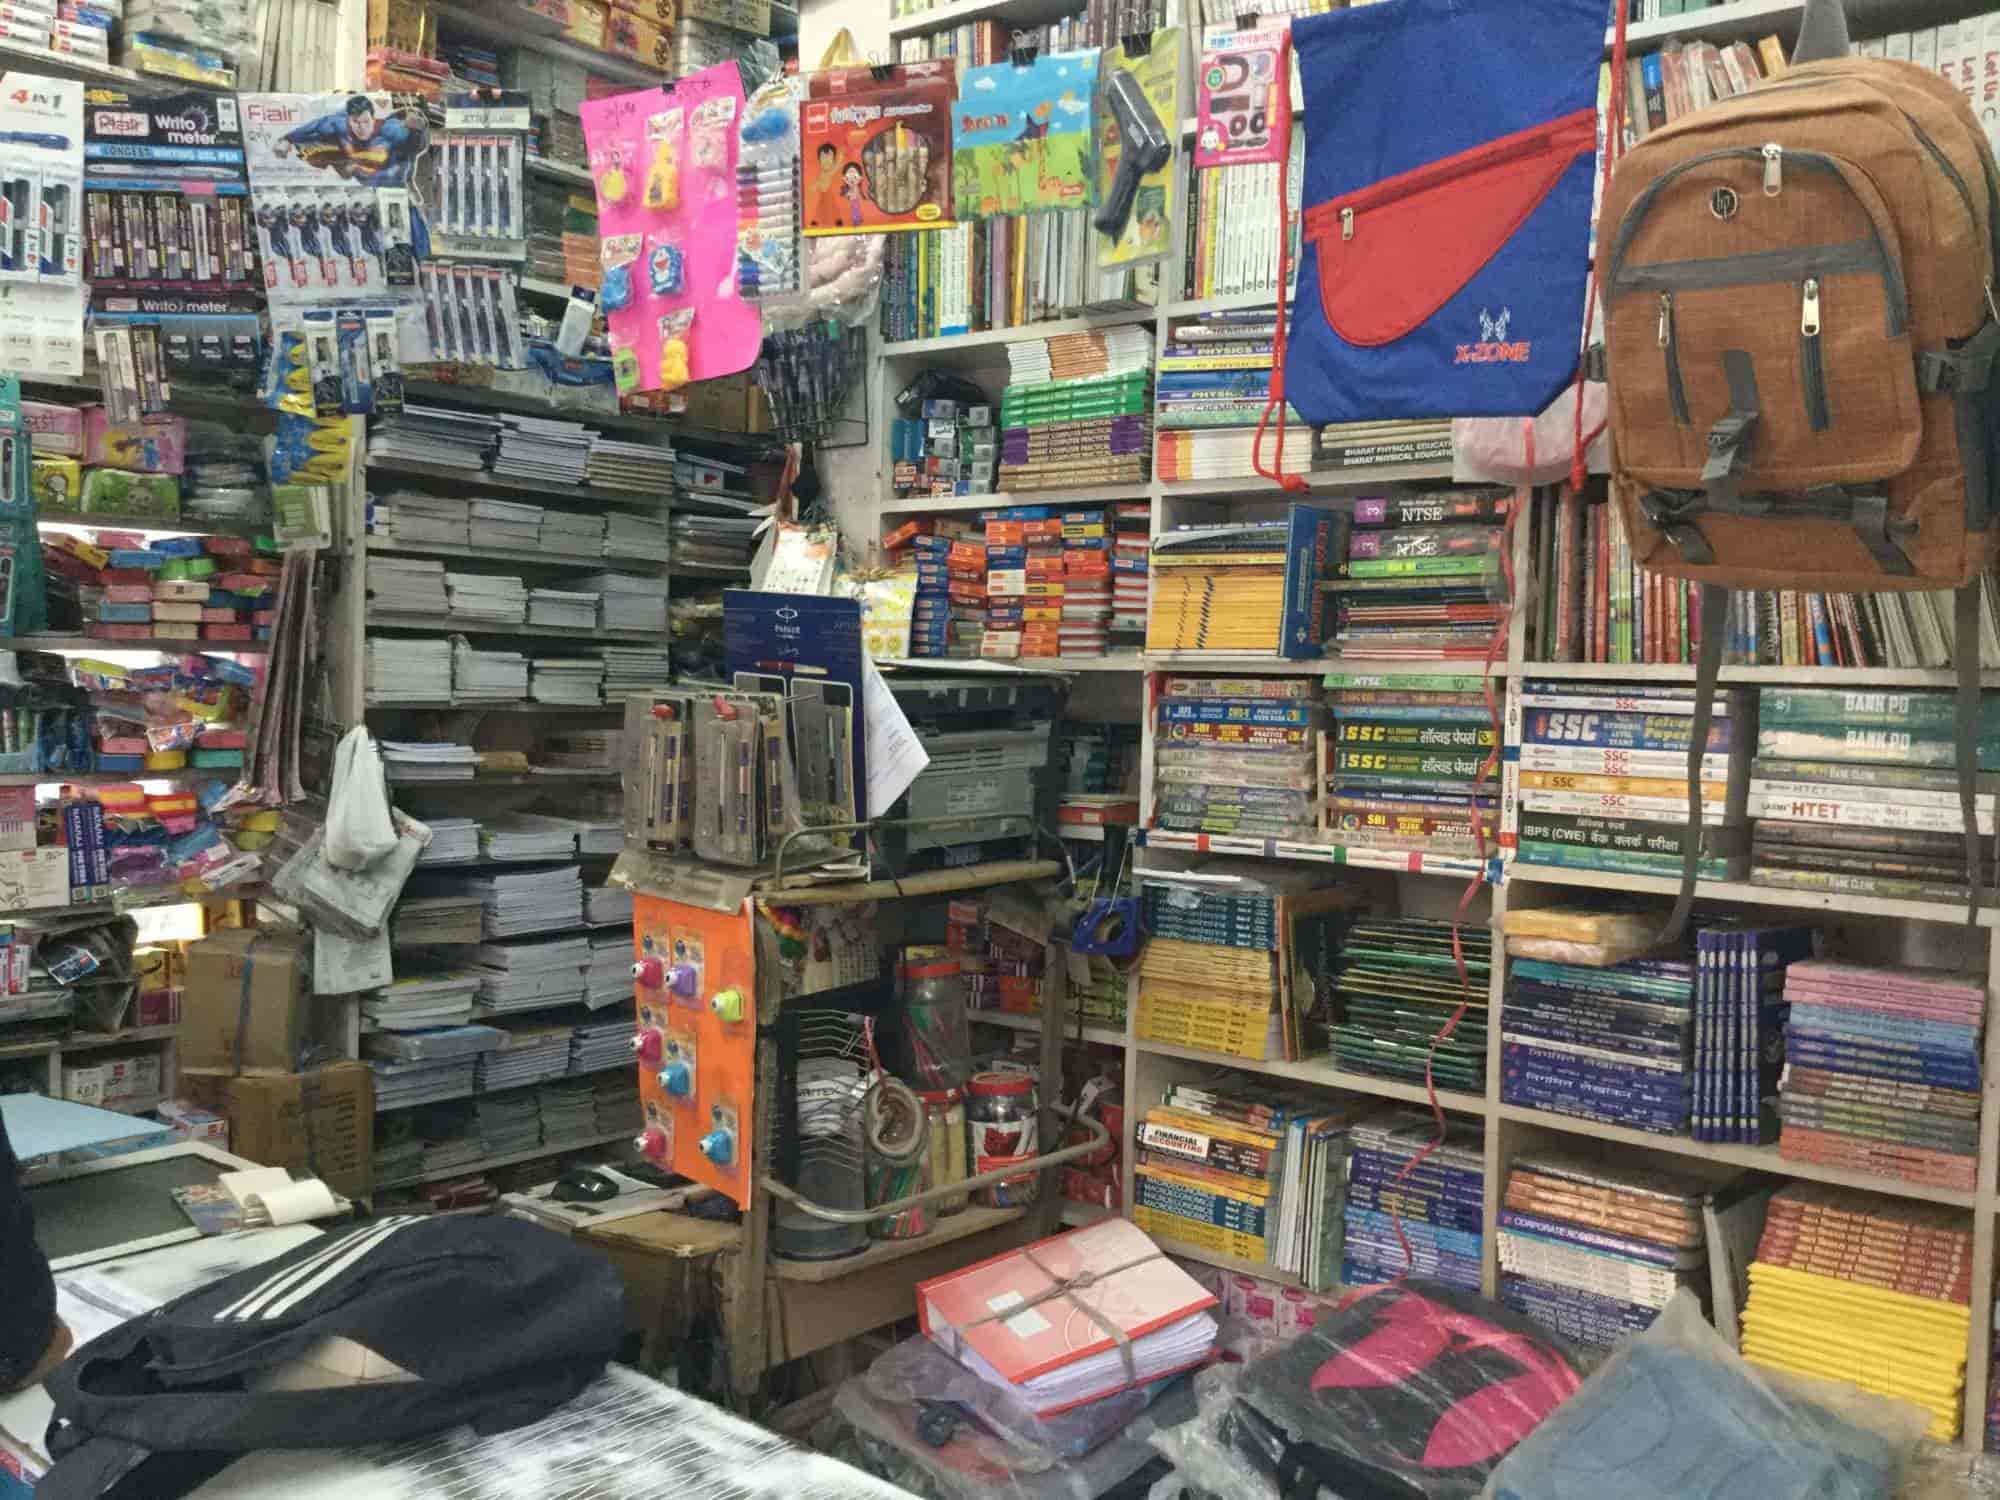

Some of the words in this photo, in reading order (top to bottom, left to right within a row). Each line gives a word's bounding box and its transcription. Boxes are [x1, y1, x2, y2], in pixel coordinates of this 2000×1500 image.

[247, 103, 299, 123] Flair
[154, 114, 197, 131] Writo
[168, 131, 217, 145] meter
[143, 300, 178, 313] Writo
[186, 301, 228, 314] meter
[1401, 507, 1443, 522] NTSE
[1395, 542, 1437, 557] NTSE
[1615, 698, 1640, 710] SSC
[1845, 694, 1885, 713] BANK
[1888, 695, 1910, 714] PO
[1346, 726, 1386, 742] SSC
[1547, 713, 1600, 742] SSC
[1347, 754, 1387, 769] SSC
[1603, 750, 1629, 762] SSC
[1603, 763, 1629, 774] SSC
[1551, 776, 1576, 788] SSC
[1600, 795, 1626, 807] SSC
[1791, 801, 1841, 819] HTET
[1523, 825, 1550, 840] IBPS
[1153, 1129, 1198, 1146] FINANCIAL
[1513, 1216, 1567, 1237] CORPORATE
